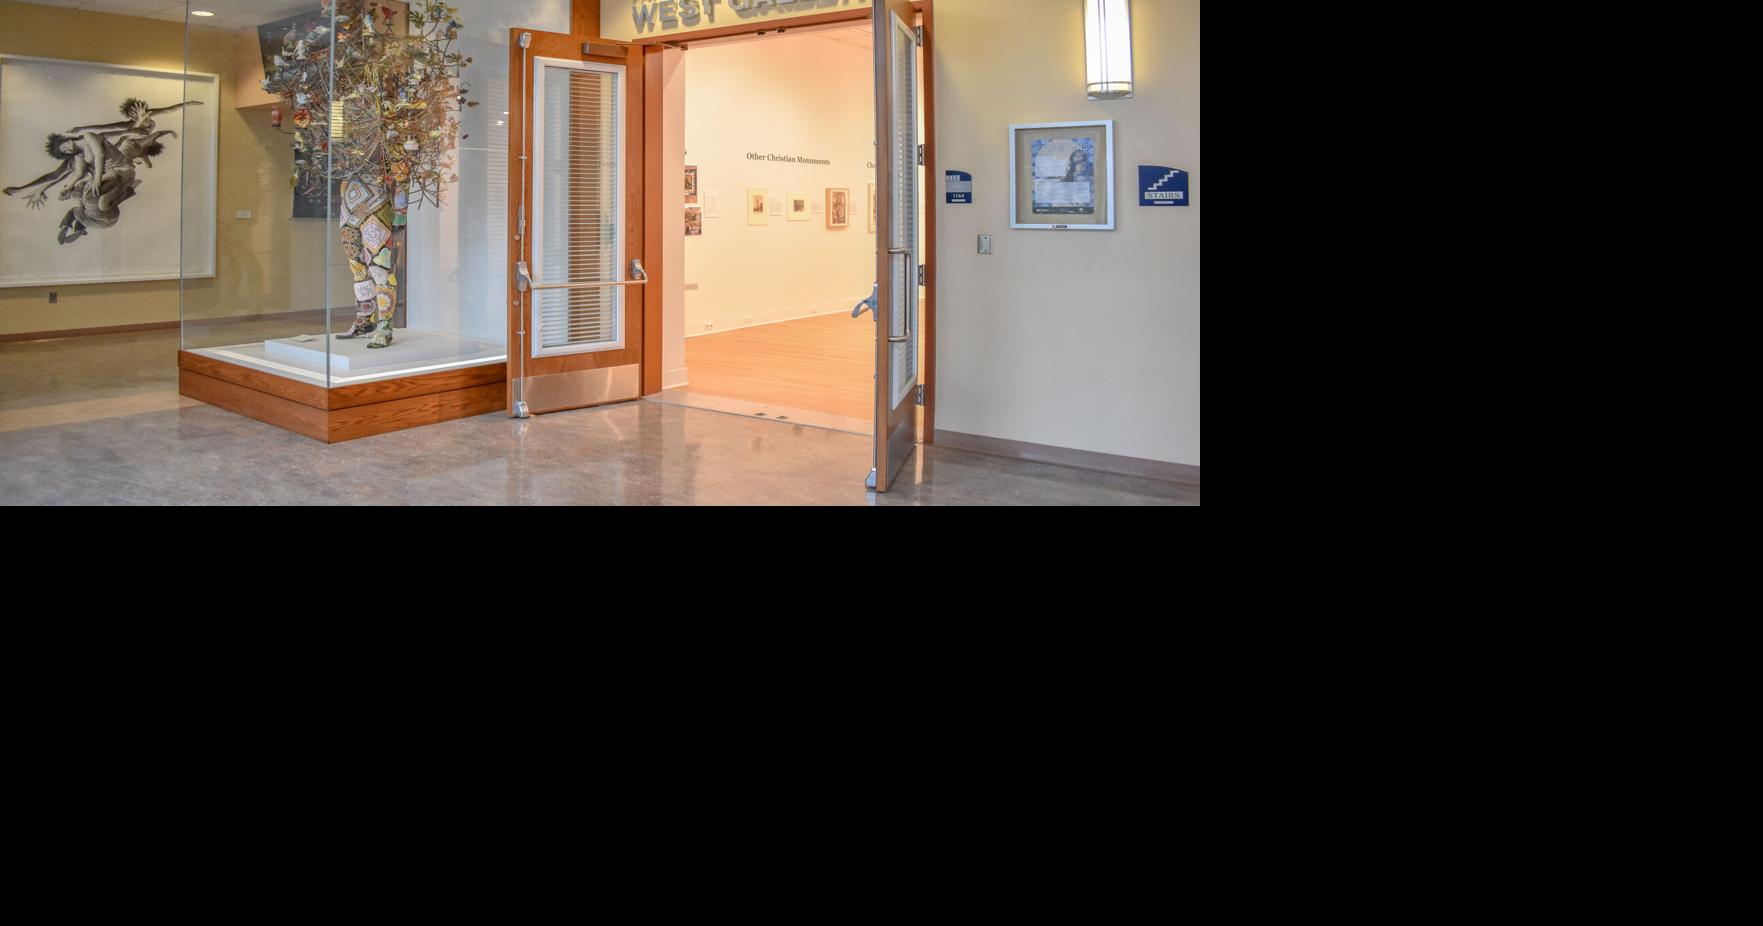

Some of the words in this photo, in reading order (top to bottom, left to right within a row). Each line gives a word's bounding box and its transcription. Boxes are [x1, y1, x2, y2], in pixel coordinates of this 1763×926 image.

[631, 0, 717, 33] WEST
[746, 152, 766, 161] Other
[767, 153, 796, 163] Christian
[797, 156, 831, 166] Monuments
[1147, 191, 1181, 199] STAIRS
